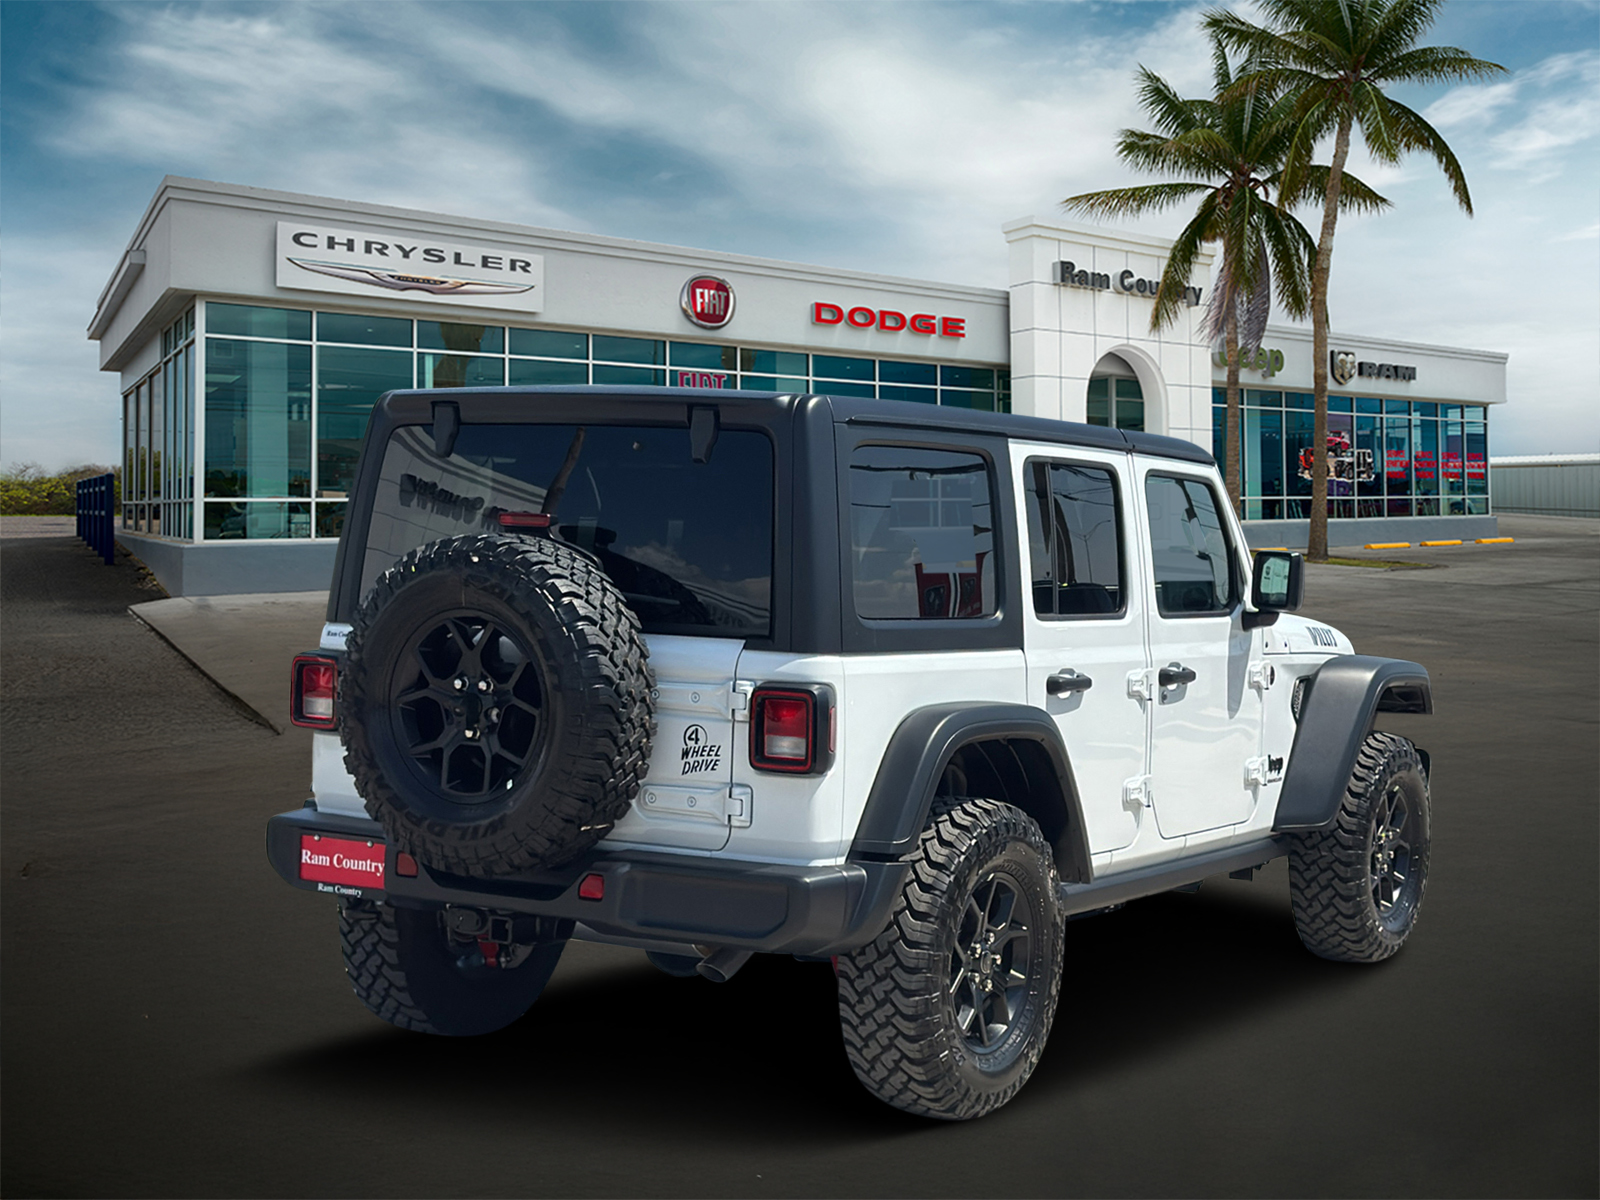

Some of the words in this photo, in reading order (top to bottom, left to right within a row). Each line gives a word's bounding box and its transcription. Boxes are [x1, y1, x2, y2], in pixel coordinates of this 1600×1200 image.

[292, 232, 532, 273] CHRYSLER
[1056, 260, 1110, 289] Ram
[695, 288, 727, 316] FIAT
[812, 302, 966, 338] DODGE
[1358, 361, 1416, 380] RAM
[687, 727, 700, 745] 4
[681, 745, 721, 760] WHEEL
[681, 759, 721, 775] DRIVE
[301, 849, 330, 866] Ram
[333, 853, 385, 876] Country
[318, 883, 333, 892] Ram
[335, 885, 362, 897] Country
